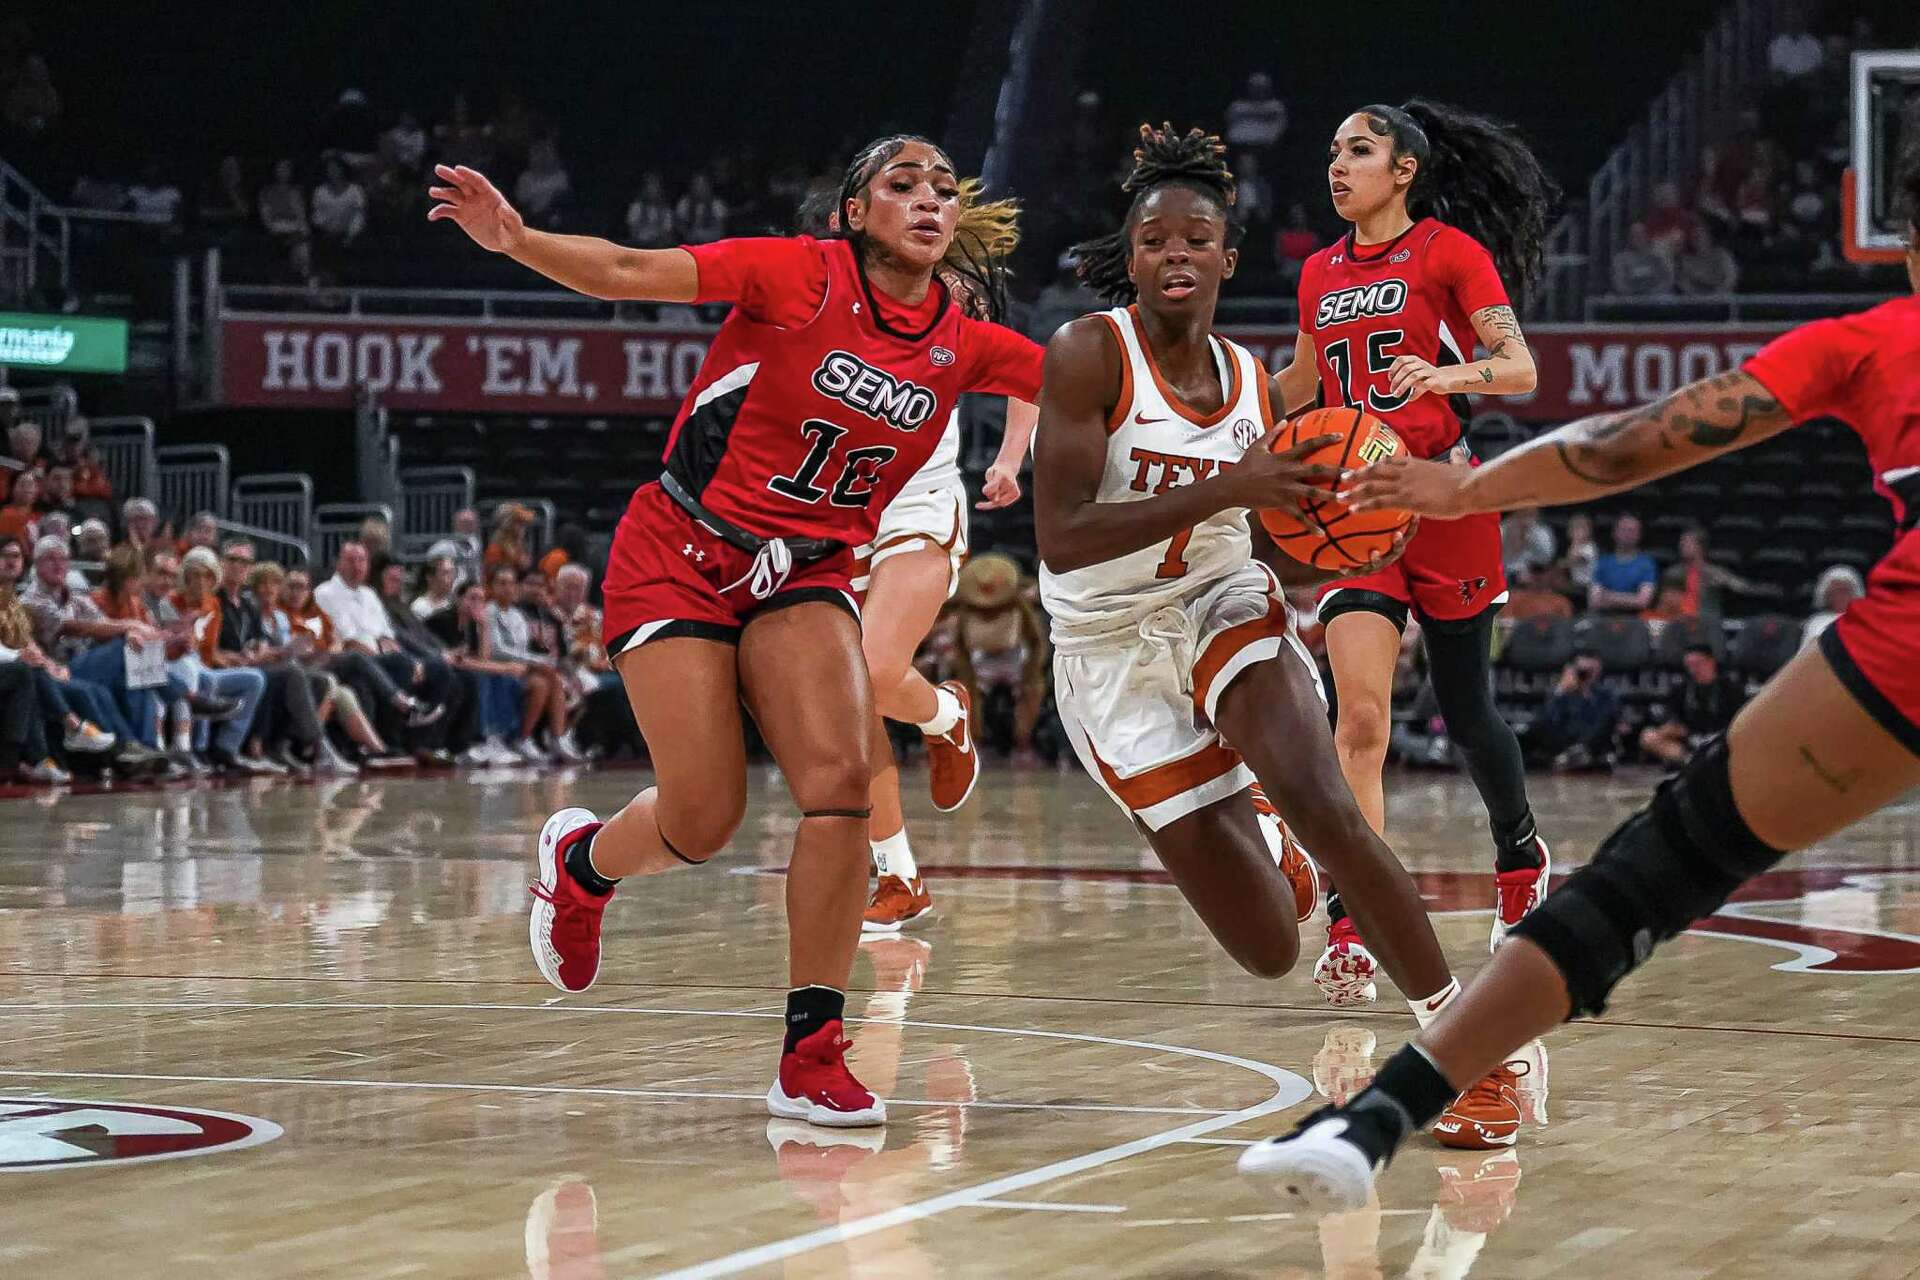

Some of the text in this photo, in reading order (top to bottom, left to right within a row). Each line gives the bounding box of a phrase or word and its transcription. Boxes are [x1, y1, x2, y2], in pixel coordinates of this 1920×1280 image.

[1315, 279, 1407, 329] SEMO
[262, 331, 442, 392] HOOK
[466, 335, 597, 400] 'EM,
[813, 351, 937, 431] SEMO
[1569, 343, 1761, 404] MOO
